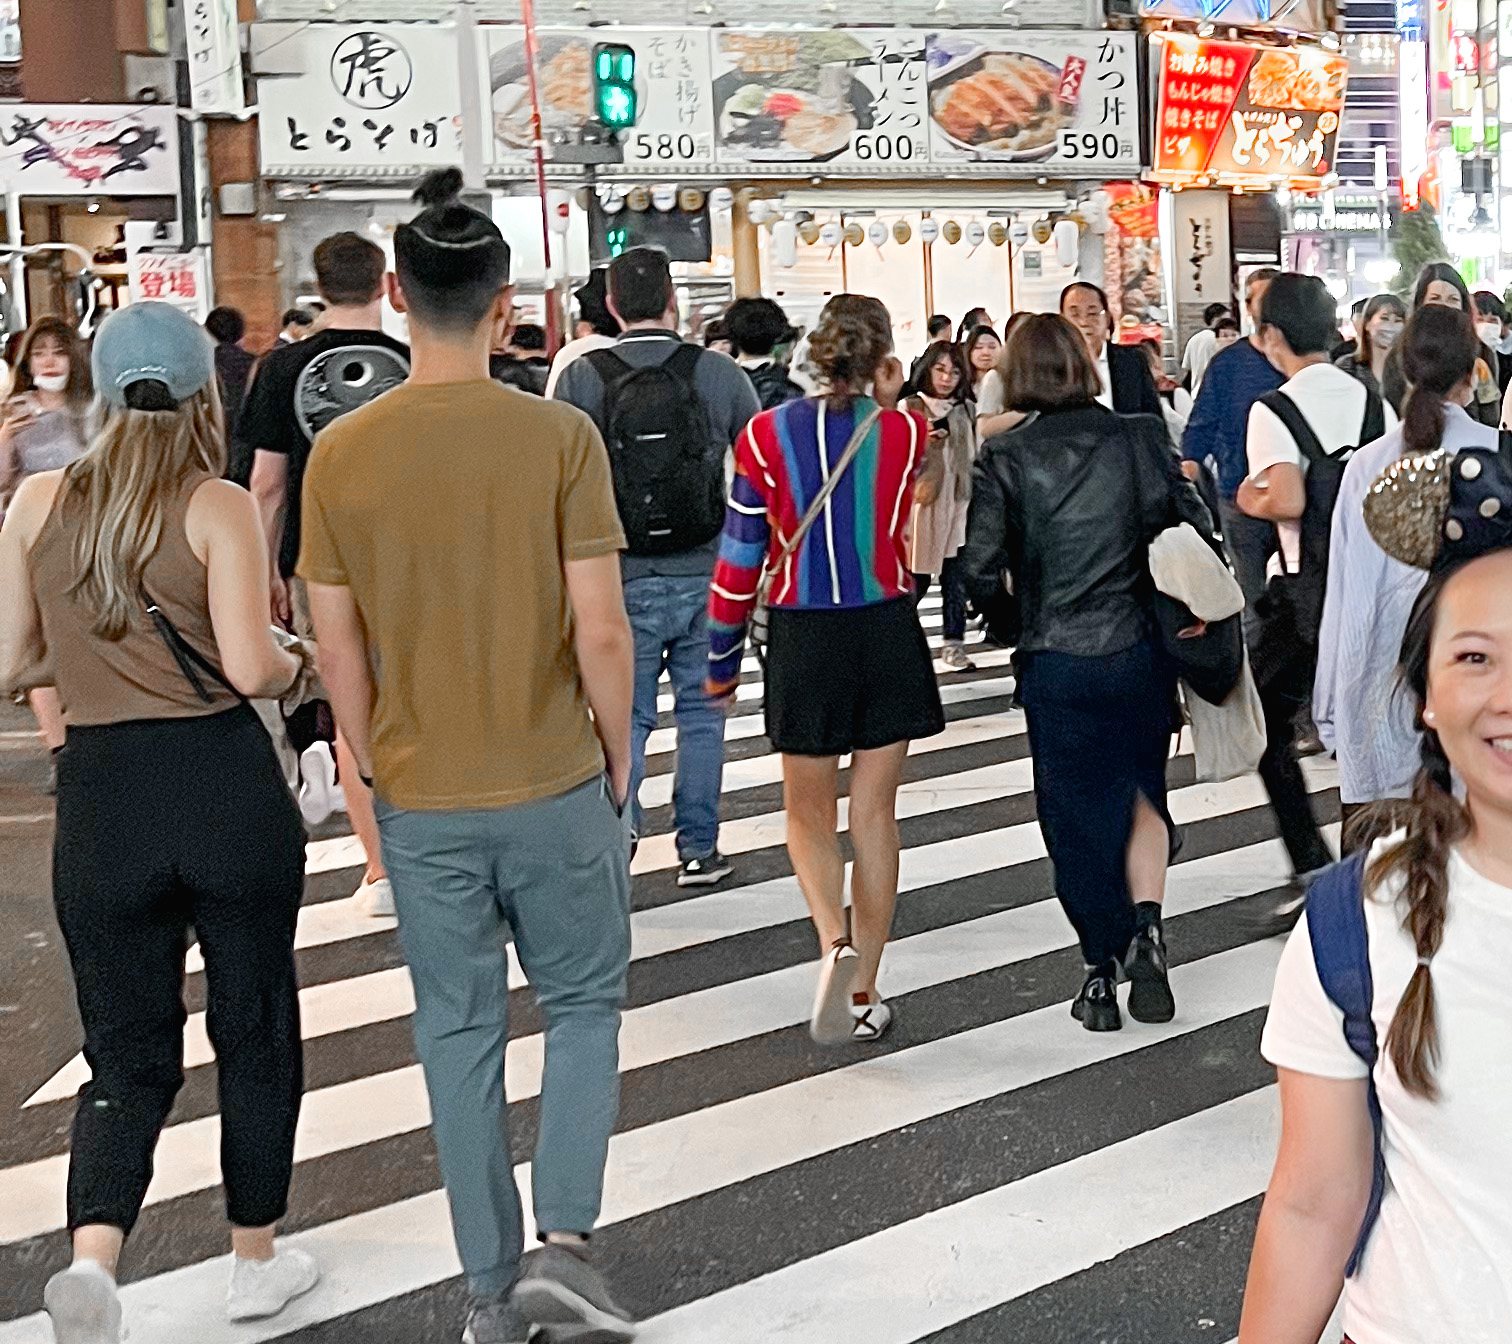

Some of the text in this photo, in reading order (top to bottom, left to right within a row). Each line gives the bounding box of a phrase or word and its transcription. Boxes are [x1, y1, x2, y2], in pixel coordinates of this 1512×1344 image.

[340, 33, 403, 100] 虎
[675, 34, 700, 126] かき揚げ
[1097, 37, 1126, 126] かつ丼
[1168, 53, 1236, 78] お好み焼き
[287, 116, 447, 152] とらそば
[1165, 106, 1222, 130] 焼きそば
[140, 270, 197, 299] 登場
